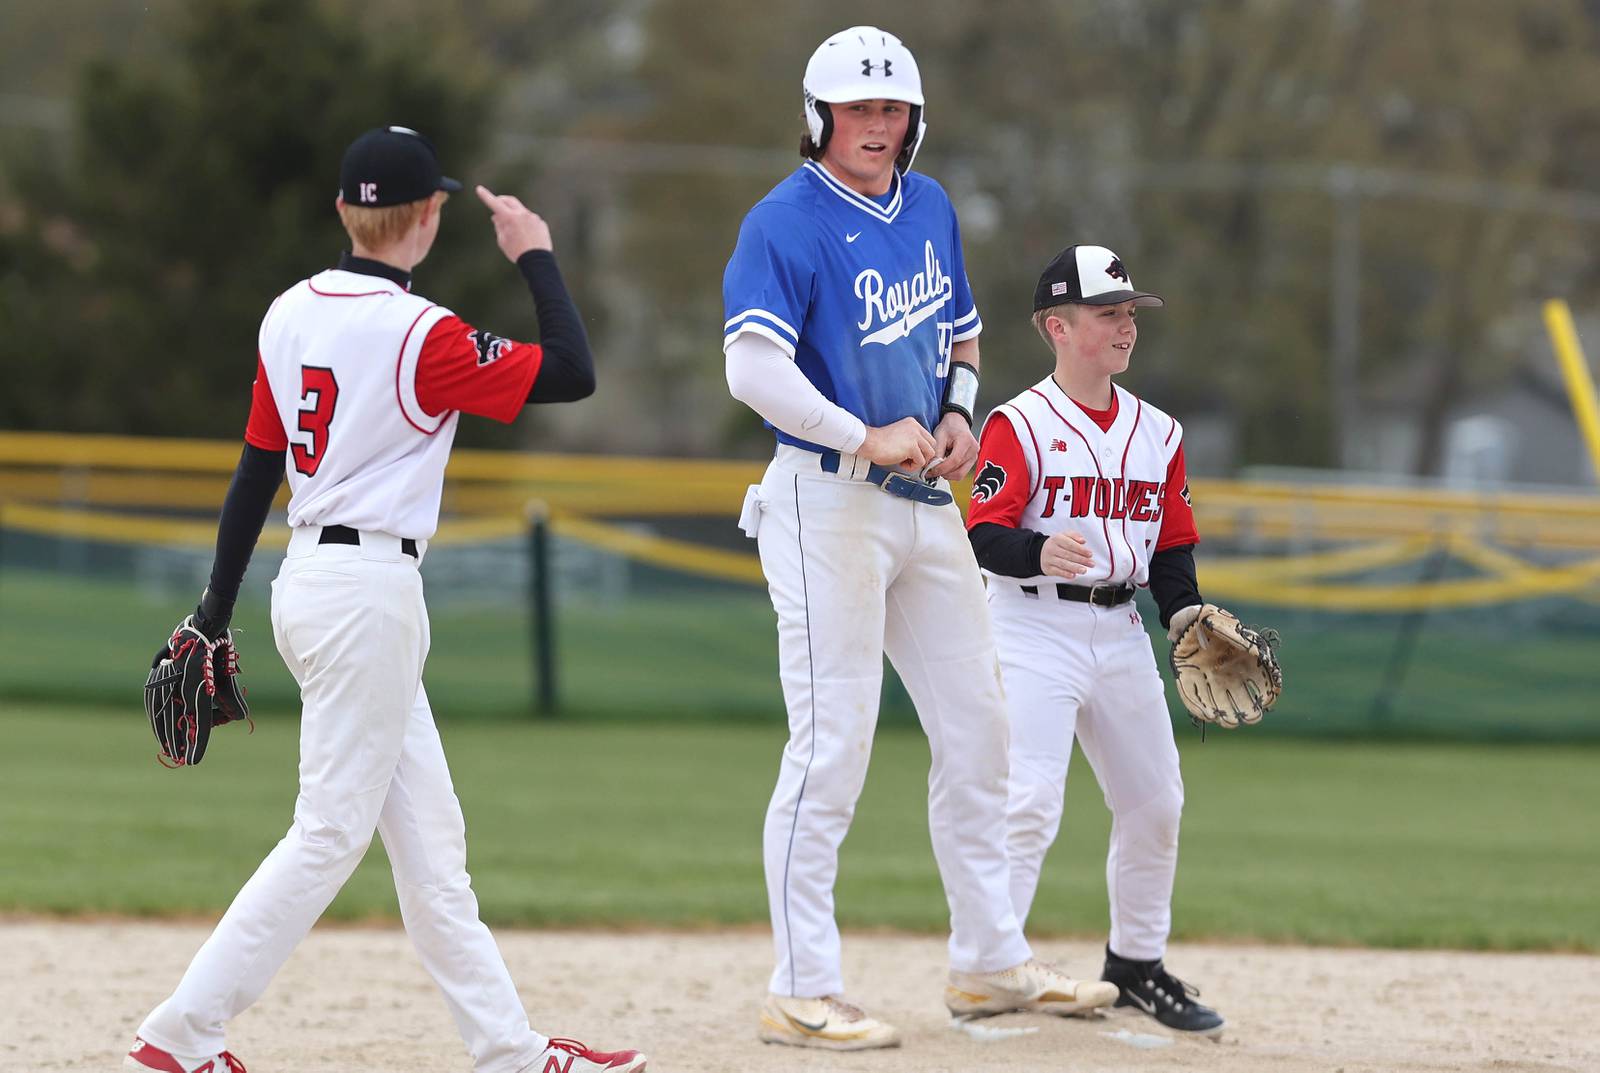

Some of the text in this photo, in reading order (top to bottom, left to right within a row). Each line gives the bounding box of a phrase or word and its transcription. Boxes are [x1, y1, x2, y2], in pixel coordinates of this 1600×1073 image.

[360, 182, 378, 203] IC
[854, 239, 952, 346] Royals
[289, 364, 340, 478] 3
[1040, 475, 1167, 522] T-WOLVES
